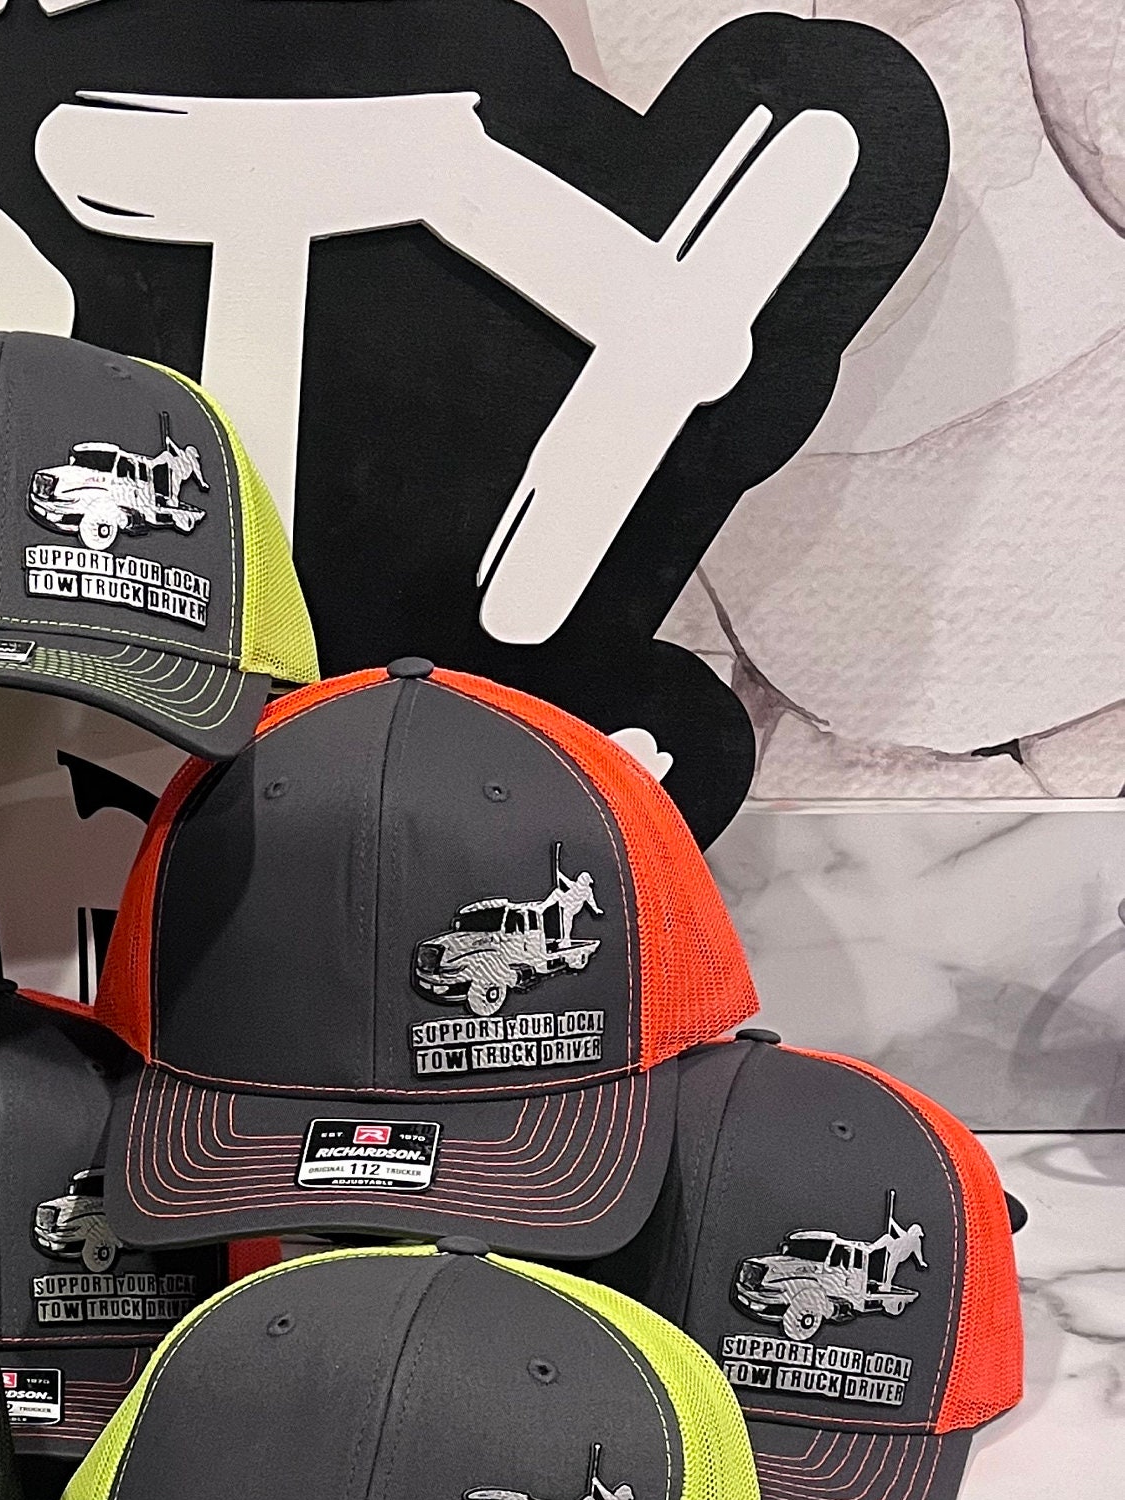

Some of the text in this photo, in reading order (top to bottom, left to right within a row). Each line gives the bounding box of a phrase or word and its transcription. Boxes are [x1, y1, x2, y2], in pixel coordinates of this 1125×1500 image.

[28, 550, 210, 599] SUPPORT YOUR LOCAL
[31, 573, 206, 622] TOW TRUCK DRIVER
[414, 1012, 603, 1043] SUPPORT YOUR LOCAL
[418, 1039, 600, 1069] TOW TRUCK DRIVER
[316, 1147, 420, 1160] RICHARDSON
[350, 1163, 381, 1175] 112
[386, 1168, 421, 1176] TRUCKER
[35, 1276, 112, 1294] SUPPORT
[117, 1276, 155, 1294] YOUR
[40, 1303, 80, 1318] TOW
[88, 1300, 141, 1317] TRUCK
[725, 1339, 910, 1379] SUPPORT YOUR LOCAL
[726, 1364, 903, 1402] TOW TRUCK DRIVER
